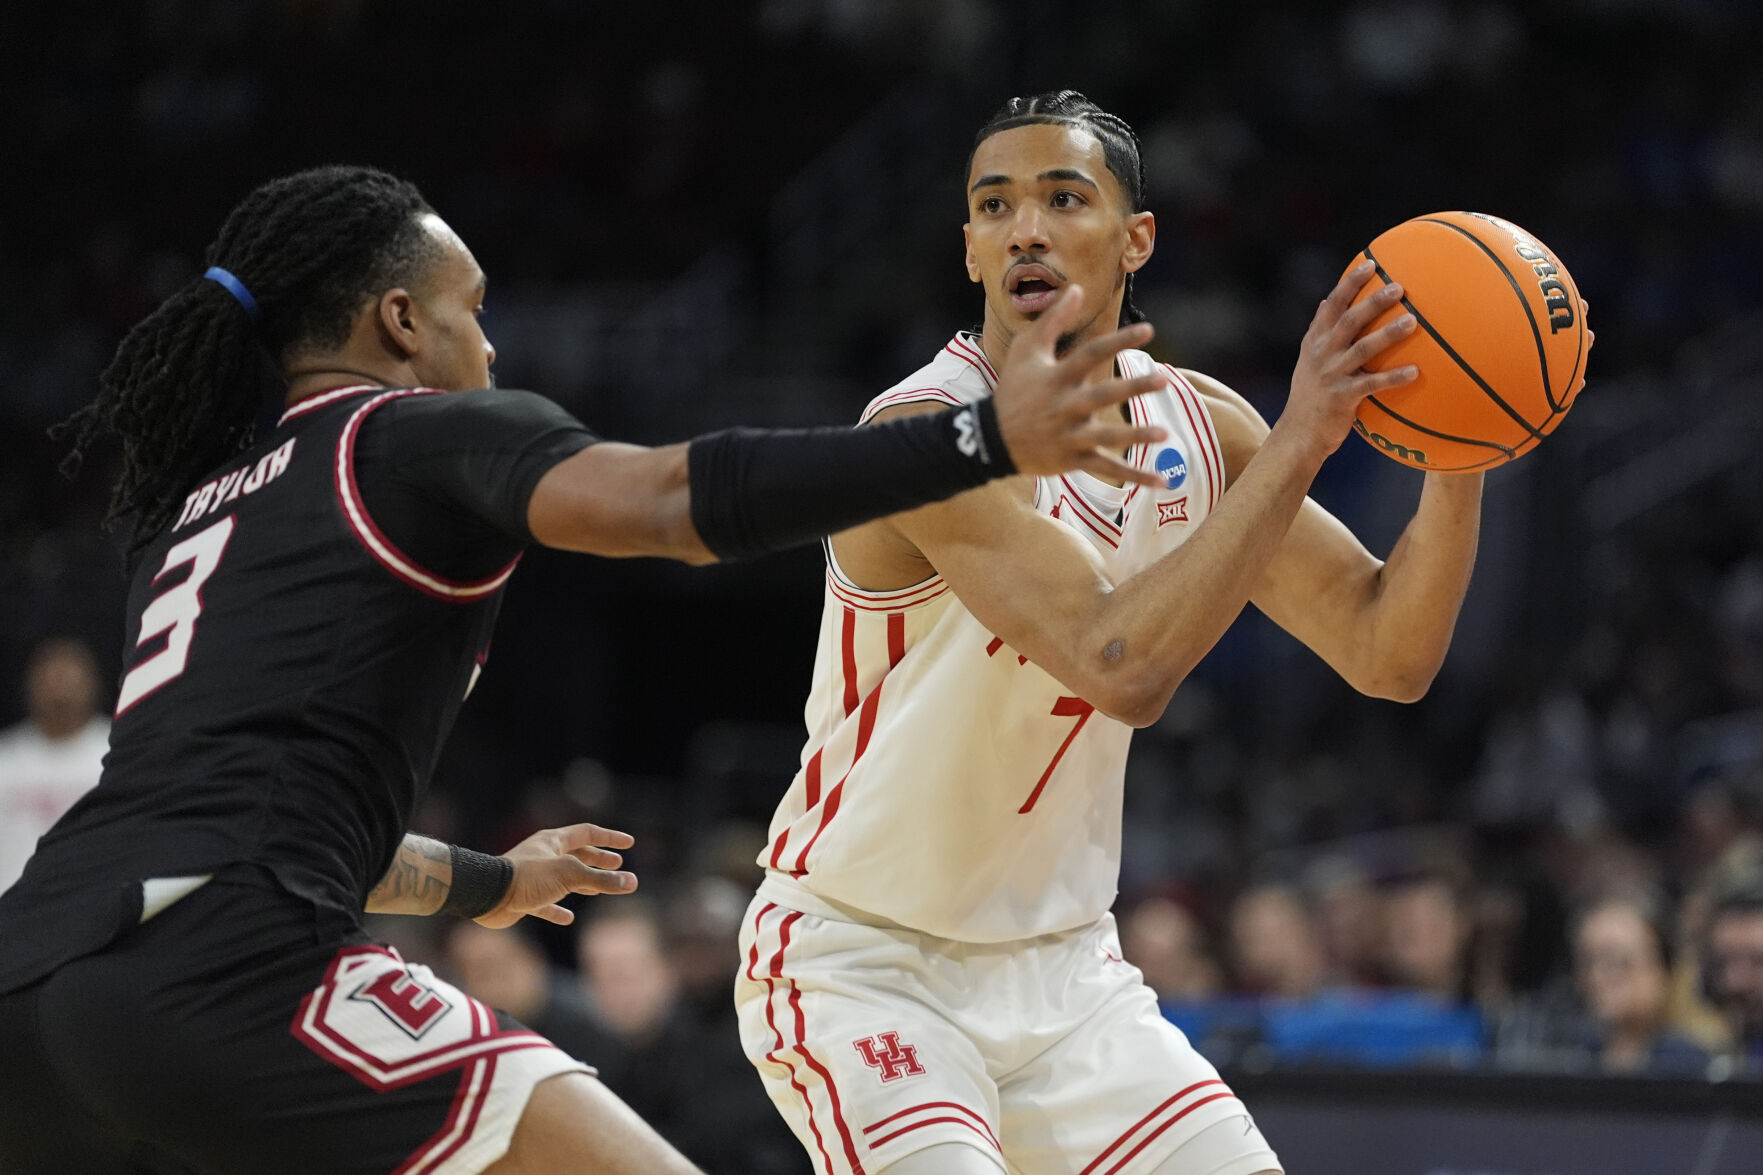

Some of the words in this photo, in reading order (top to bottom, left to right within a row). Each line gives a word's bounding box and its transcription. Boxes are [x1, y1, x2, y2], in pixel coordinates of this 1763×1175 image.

[171, 437, 296, 533] TAYLOR
[1162, 463, 1186, 481] NCAA
[113, 513, 237, 720] 3
[1018, 696, 1096, 814] 7
[347, 968, 452, 1041] E
[853, 1031, 926, 1083] UH
